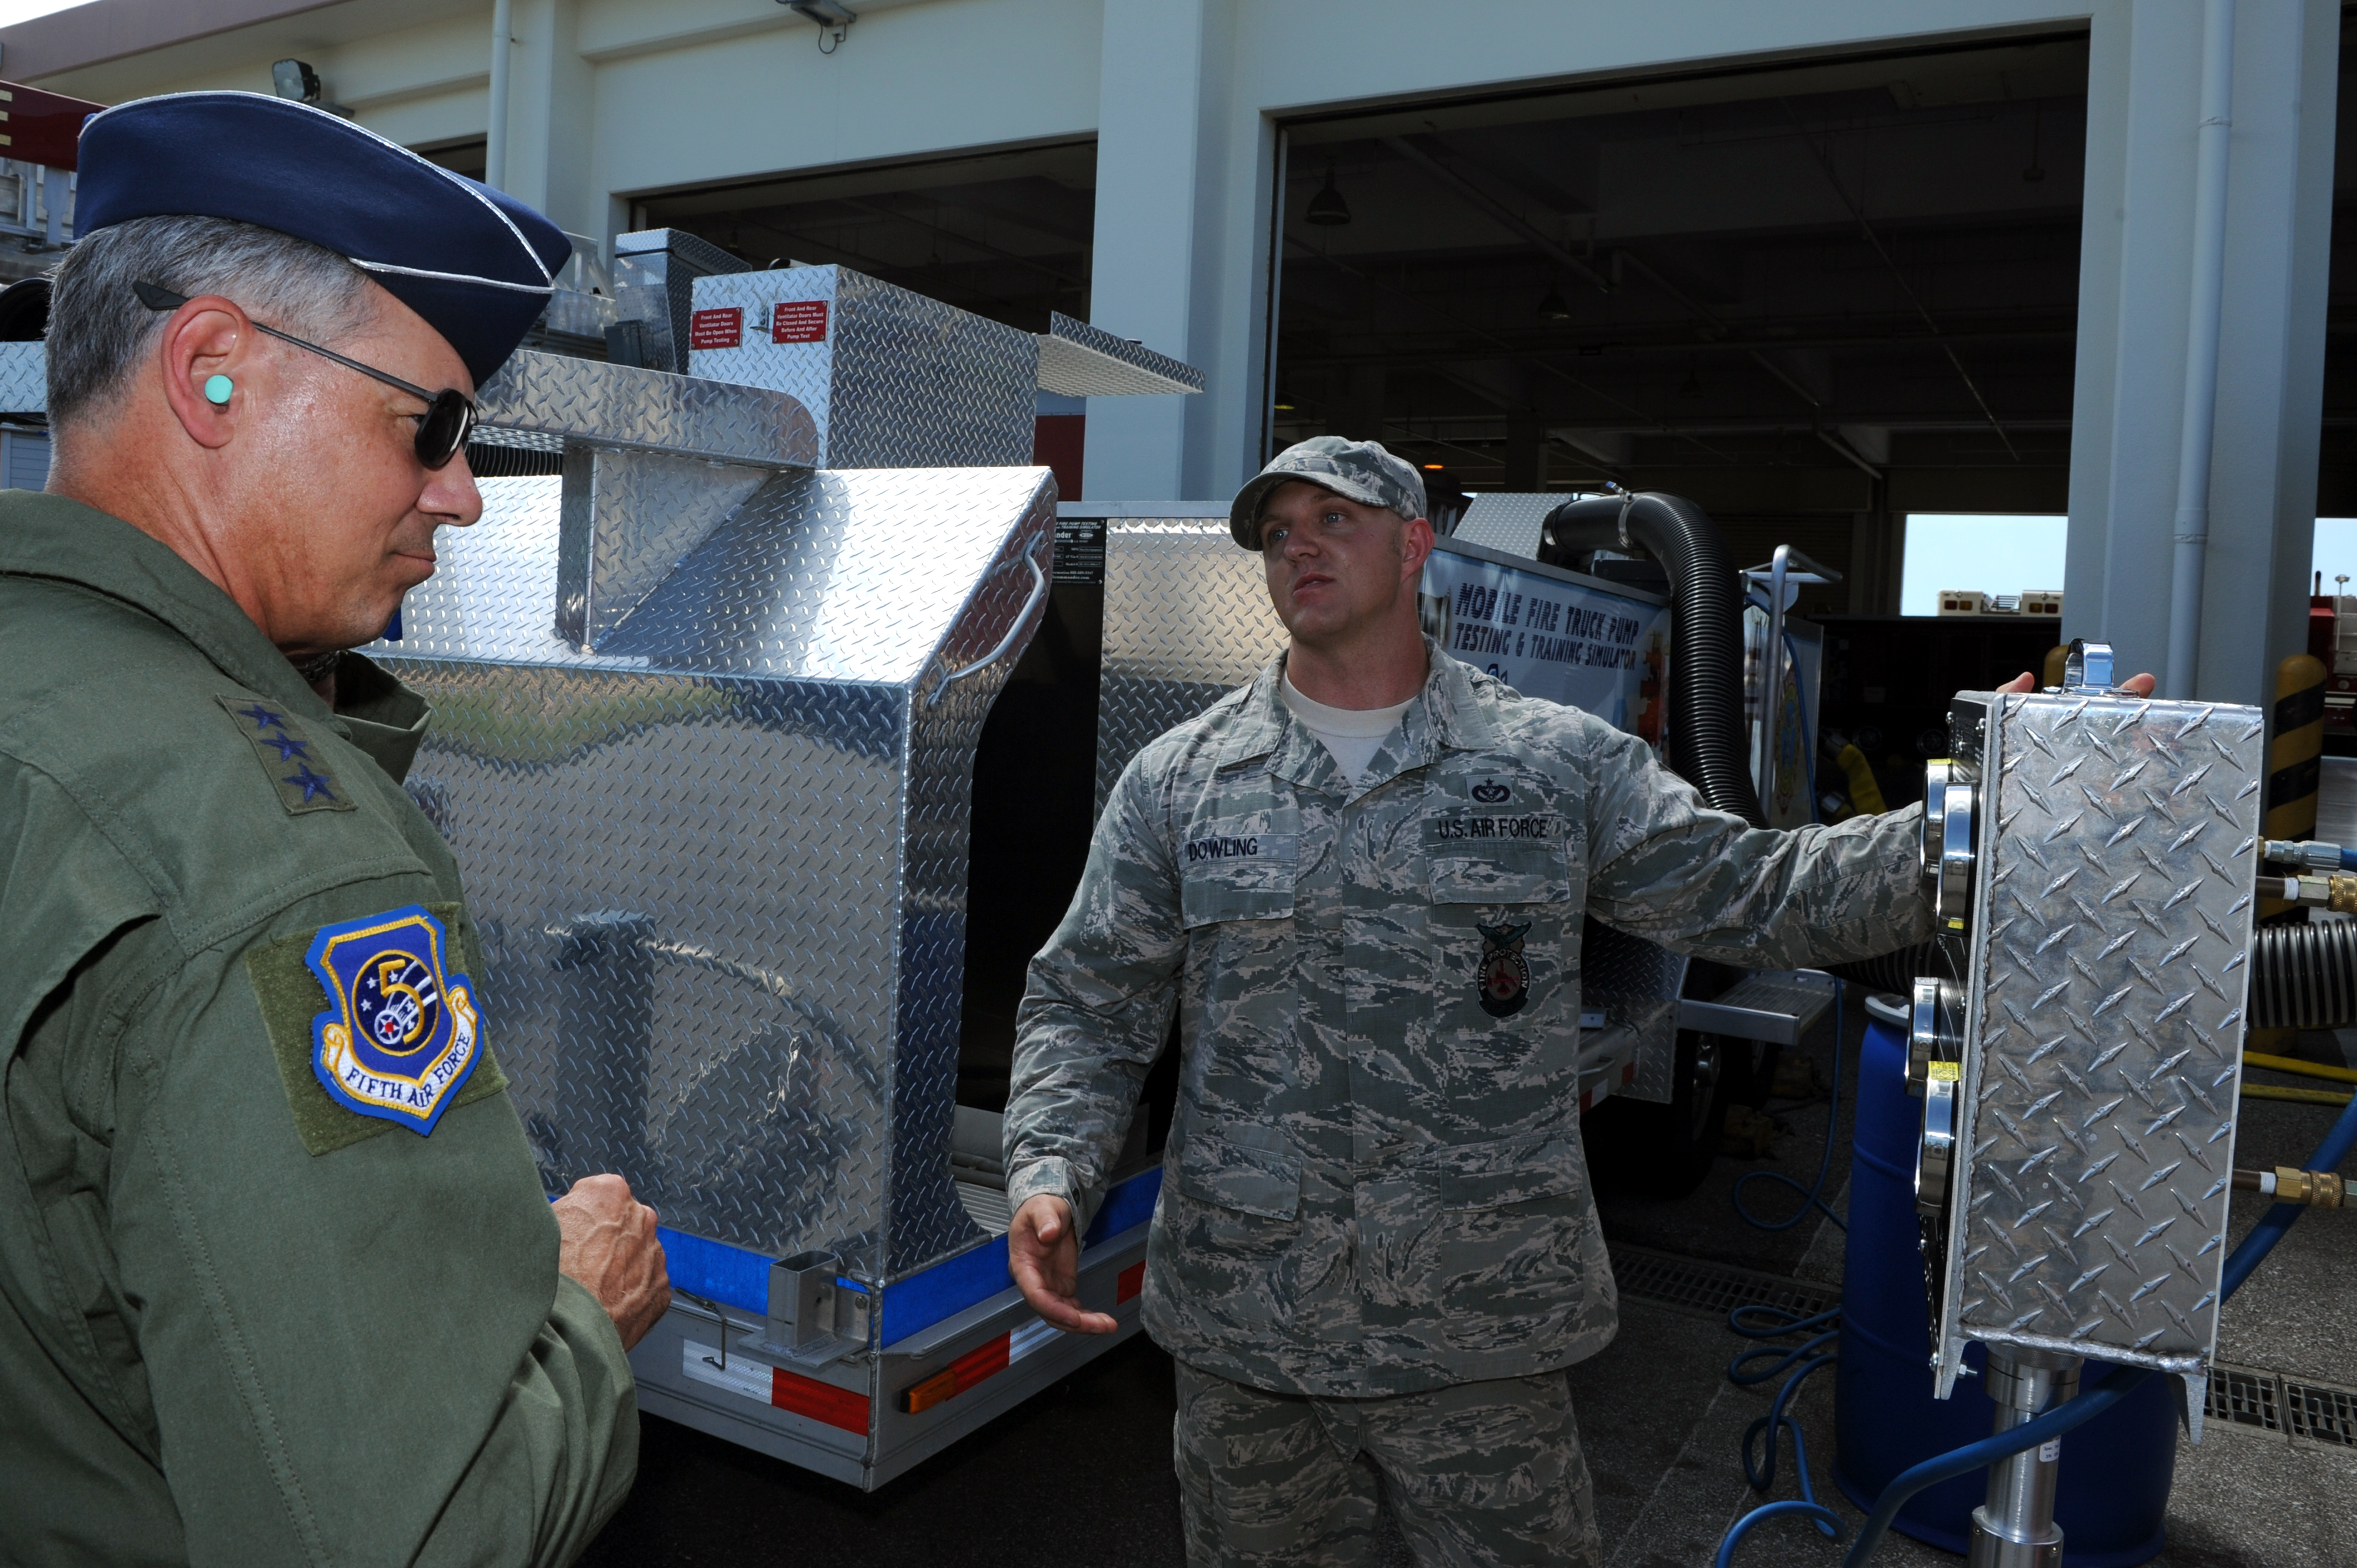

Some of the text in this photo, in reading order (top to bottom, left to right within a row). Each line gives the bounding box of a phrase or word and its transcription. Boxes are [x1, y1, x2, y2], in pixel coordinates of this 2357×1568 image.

[1454, 582, 1639, 645] MOBILE FIRE TRUCK PUMP
[1453, 622, 1637, 670] TESTING & TRAINING SIMULATOR
[1188, 837, 1258, 862] DOWLING
[1439, 819, 1548, 839] U.S. AIR FORCE
[1479, 948, 1528, 991] FIRE PROTECTION
[378, 959, 425, 1044] 5
[346, 1033, 470, 1107] FIFTH AIR FORCE
